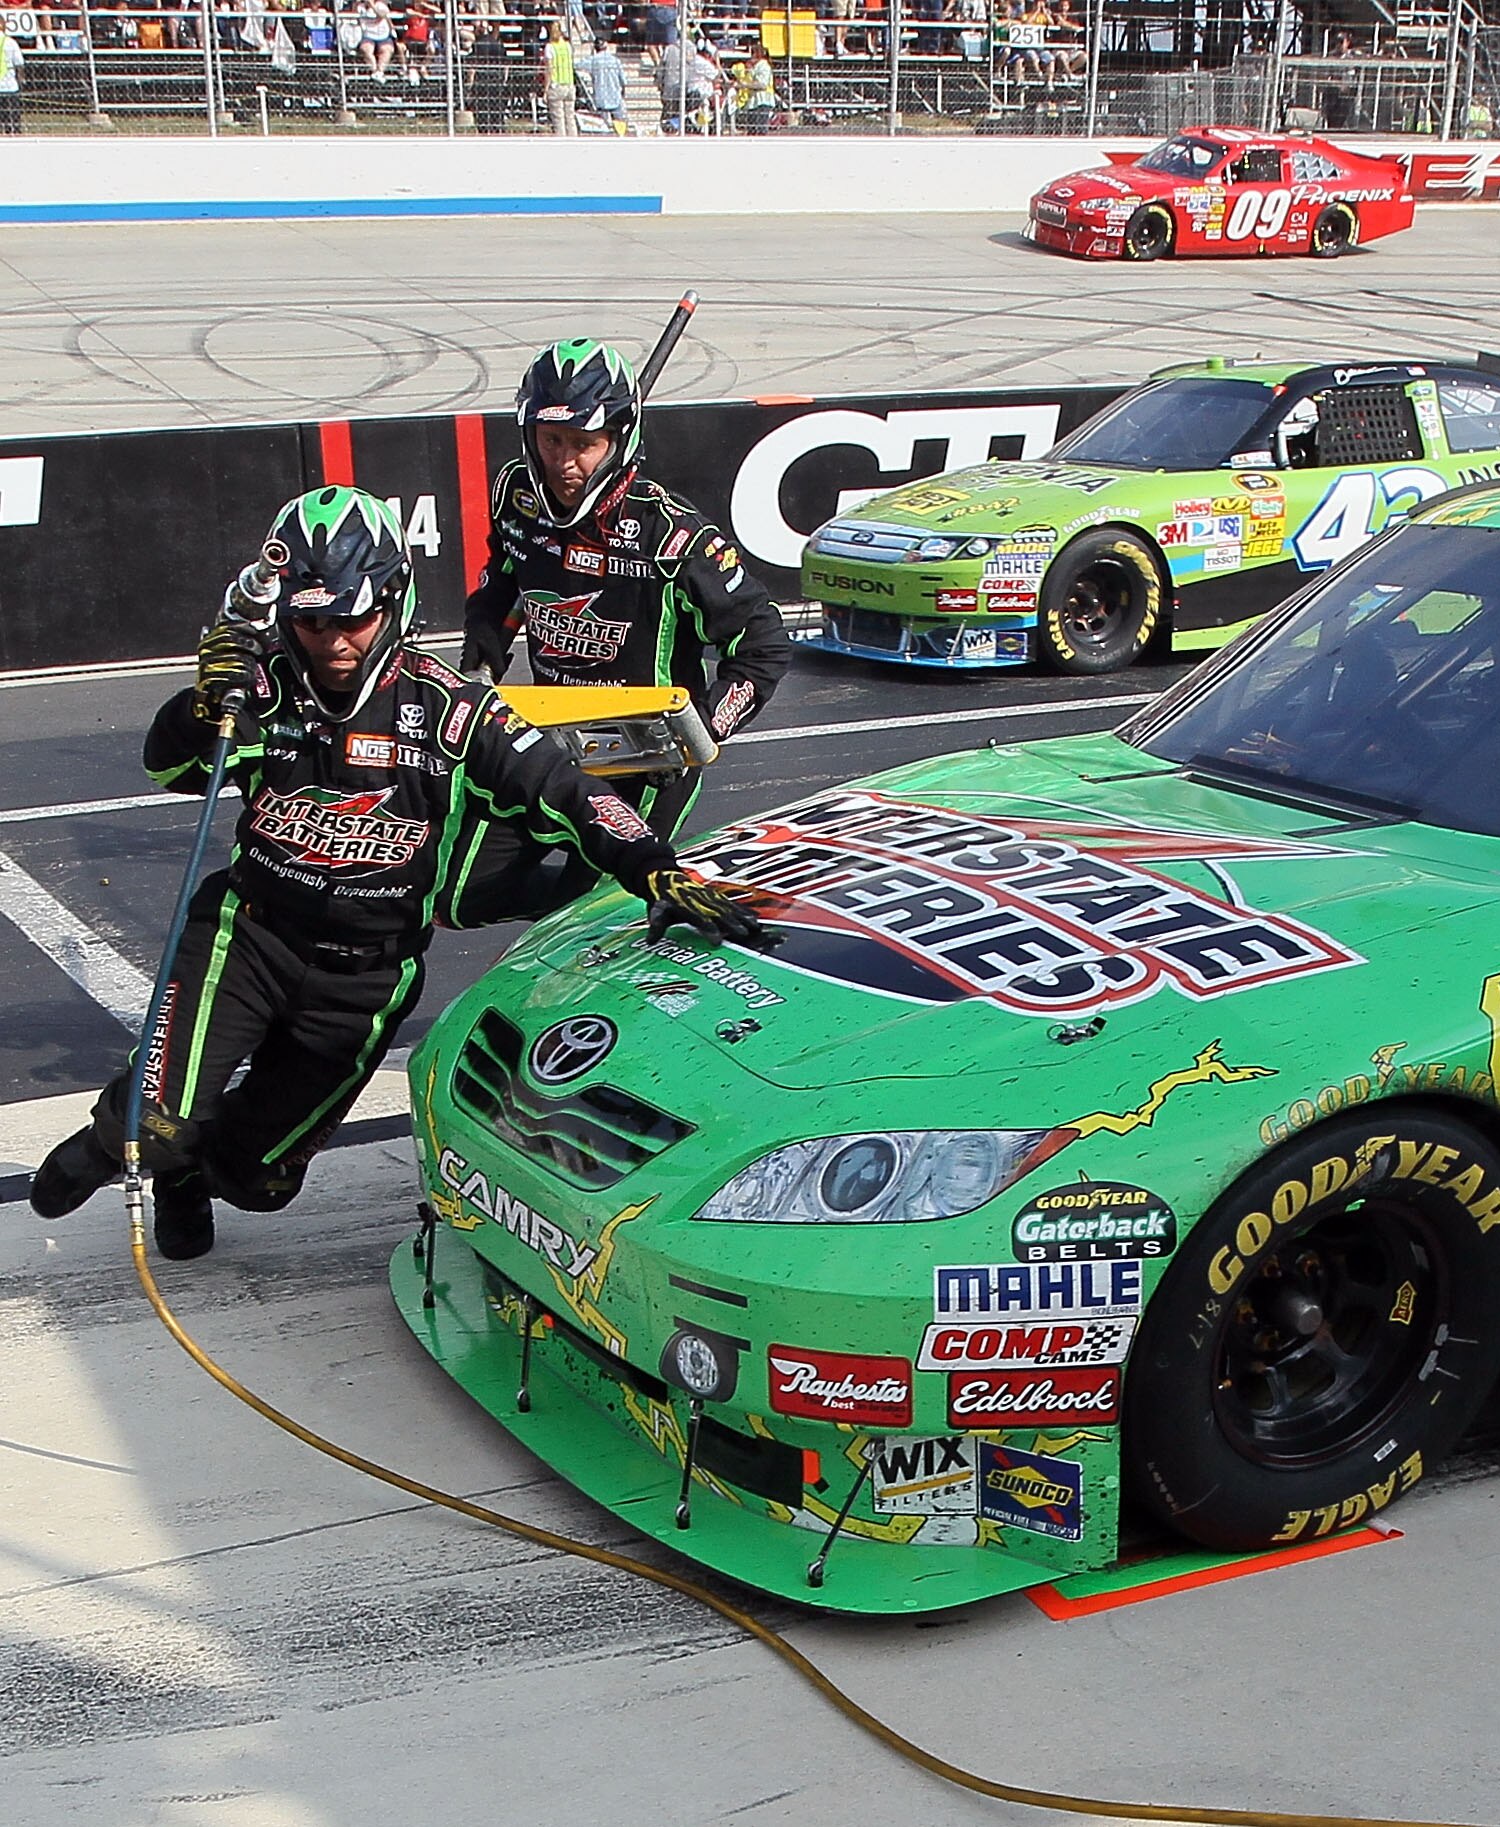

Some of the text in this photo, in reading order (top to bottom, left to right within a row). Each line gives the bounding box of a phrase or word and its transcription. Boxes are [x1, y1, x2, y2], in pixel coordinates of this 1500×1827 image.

[1010, 27, 1043, 44] 251
[1290, 184, 1394, 206] PHOENIX
[1226, 189, 1292, 240] 09
[730, 407, 1061, 568] GT
[1174, 501, 1211, 516] Holley
[1159, 522, 1188, 546] 3M
[1219, 517, 1240, 538] USG
[568, 552, 601, 570] NOS
[995, 543, 1052, 555] MOOG
[1206, 555, 1239, 567] TISSOT
[1242, 538, 1282, 558] JEGS
[984, 560, 1043, 575] MAHLE
[810, 571, 896, 597] FUSION
[982, 580, 1025, 590] COMP
[529, 618, 616, 660] ATTERIES
[964, 630, 994, 649] WIX
[1047, 608, 1076, 661] EAGLE
[447, 704, 470, 742] SIMPSON
[350, 738, 396, 760] NOS
[259, 796, 425, 845] INTERSTATE
[258, 816, 409, 864] BATTERIES
[249, 846, 328, 891] Outrageously
[692, 957, 787, 1009] Battery
[438, 1146, 596, 1279] CAMRY
[1028, 1240, 1162, 1261] BELTS
[937, 1260, 1141, 1313] MAHLE
[931, 1325, 1085, 1362] COMP
[1033, 1347, 1107, 1366] CAMS
[770, 1357, 909, 1407] Raybestos
[952, 1379, 1115, 1414] Edelbrock
[830, 1400, 855, 1410] best
[877, 1436, 971, 1485] WIX
[876, 1480, 974, 1510] FILTERS
[988, 1470, 1072, 1505] SUNOCO
[1271, 1449, 1424, 1542] EAGLE
